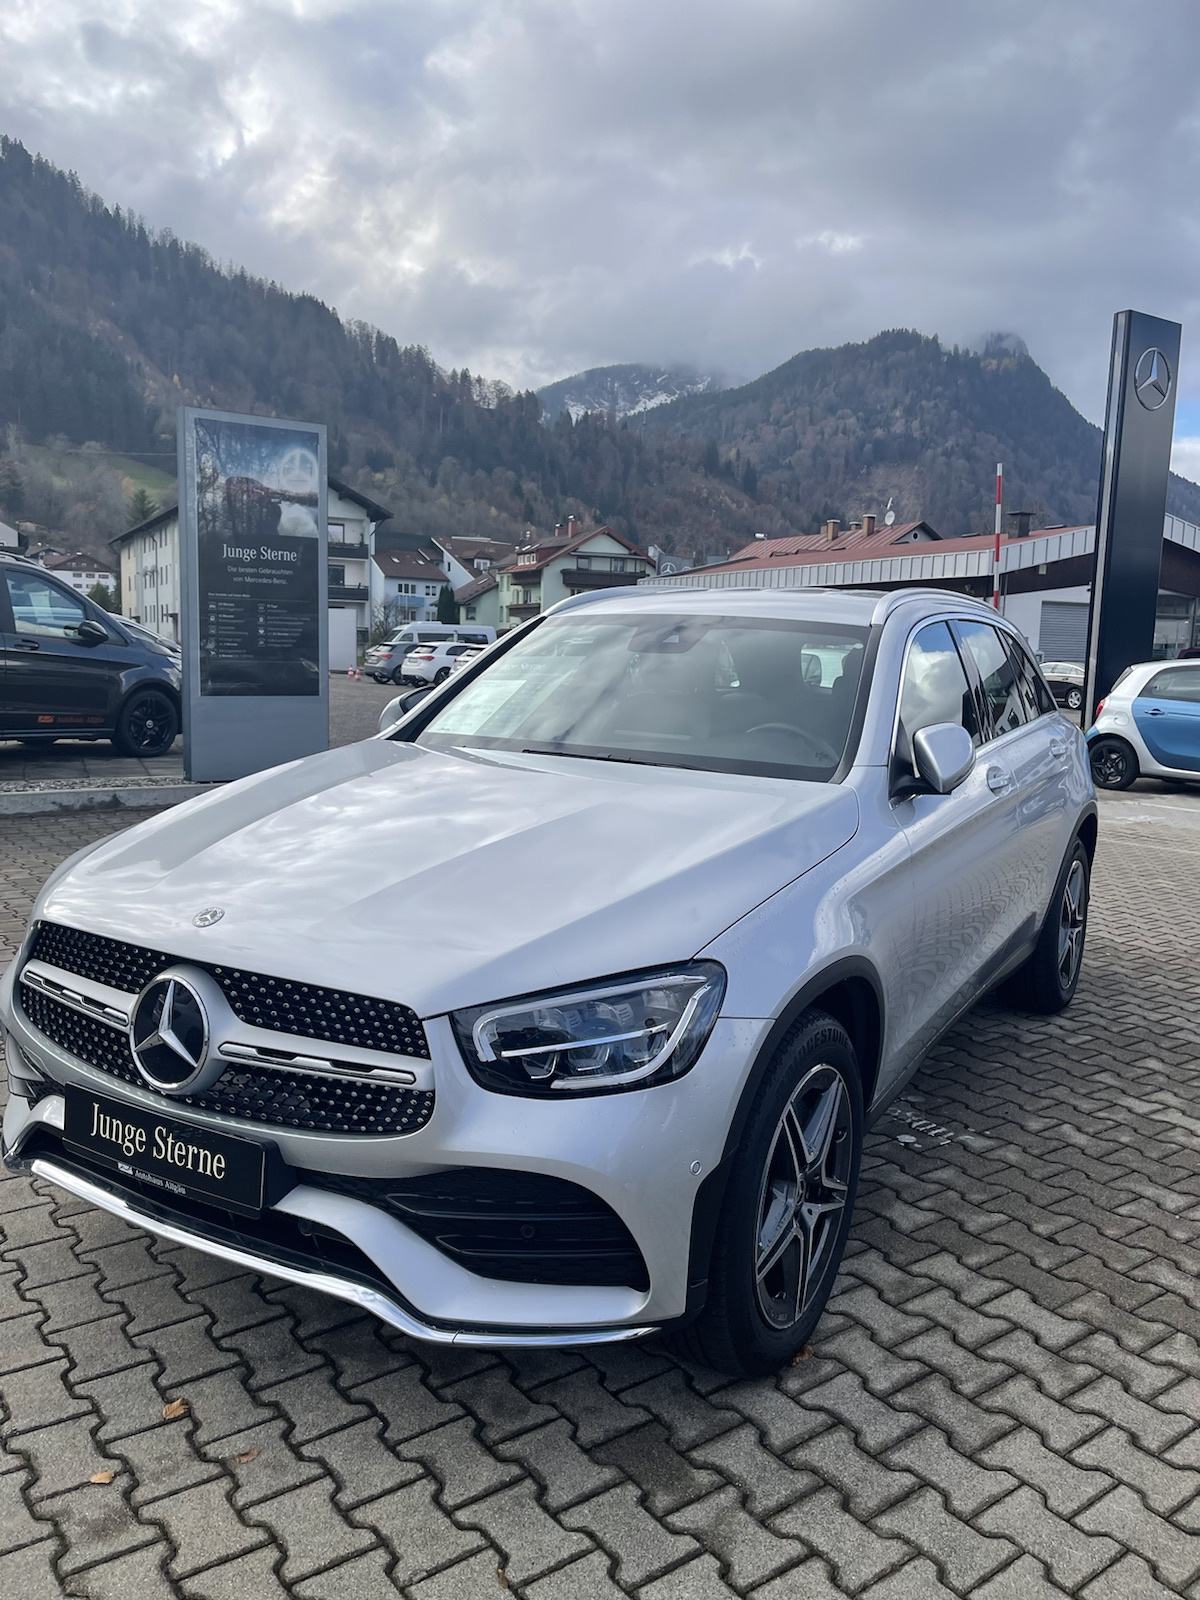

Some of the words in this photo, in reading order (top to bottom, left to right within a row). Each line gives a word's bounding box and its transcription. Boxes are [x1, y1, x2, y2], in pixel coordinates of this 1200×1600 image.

[222, 543, 257, 562] Junge
[260, 545, 297, 562] Sterne
[90, 1102, 147, 1156] Junge
[153, 1125, 225, 1179] Sterne
[134, 1169, 164, 1187] Autohaus
